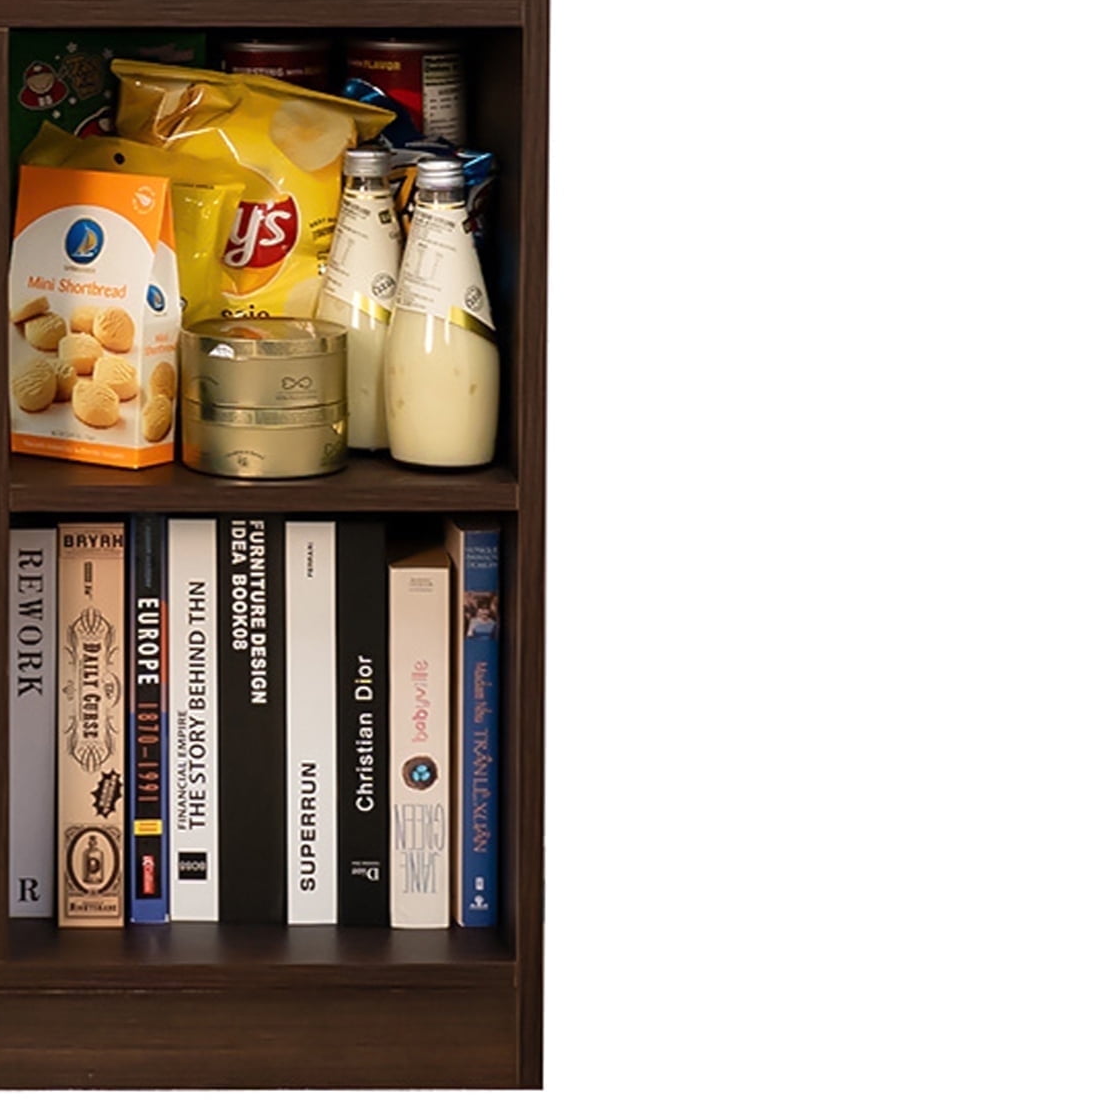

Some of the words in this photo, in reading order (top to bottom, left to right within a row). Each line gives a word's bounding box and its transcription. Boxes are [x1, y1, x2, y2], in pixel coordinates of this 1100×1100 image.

[224, 200, 292, 267] y's
[27, 276, 55, 291] Mini
[57, 278, 127, 299] Shortbread
[231, 520, 247, 565] IDEA
[250, 520, 266, 629] FURNITURE
[17, 548, 43, 696] REWORK
[188, 581, 206, 625] THN
[232, 573, 248, 651] BOOK08
[83, 643, 102, 688] DAILY
[137, 598, 159, 685] EUROPE
[188, 630, 206, 711] BEHIND
[251, 633, 267, 704] DESIGN
[355, 655, 374, 701] Dior
[411, 660, 430, 743] babyville
[83, 694, 101, 739] CURSE
[177, 710, 187, 758] EMPIRE
[188, 715, 206, 784] STORY
[355, 713, 374, 812] Christian
[177, 763, 187, 831] FINANCIAL
[188, 790, 206, 831] THE
[300, 762, 317, 891] SUPERRUN
[394, 803, 445, 851] GREEN
[18, 877, 40, 903] R
[400, 852, 441, 894] JANE
